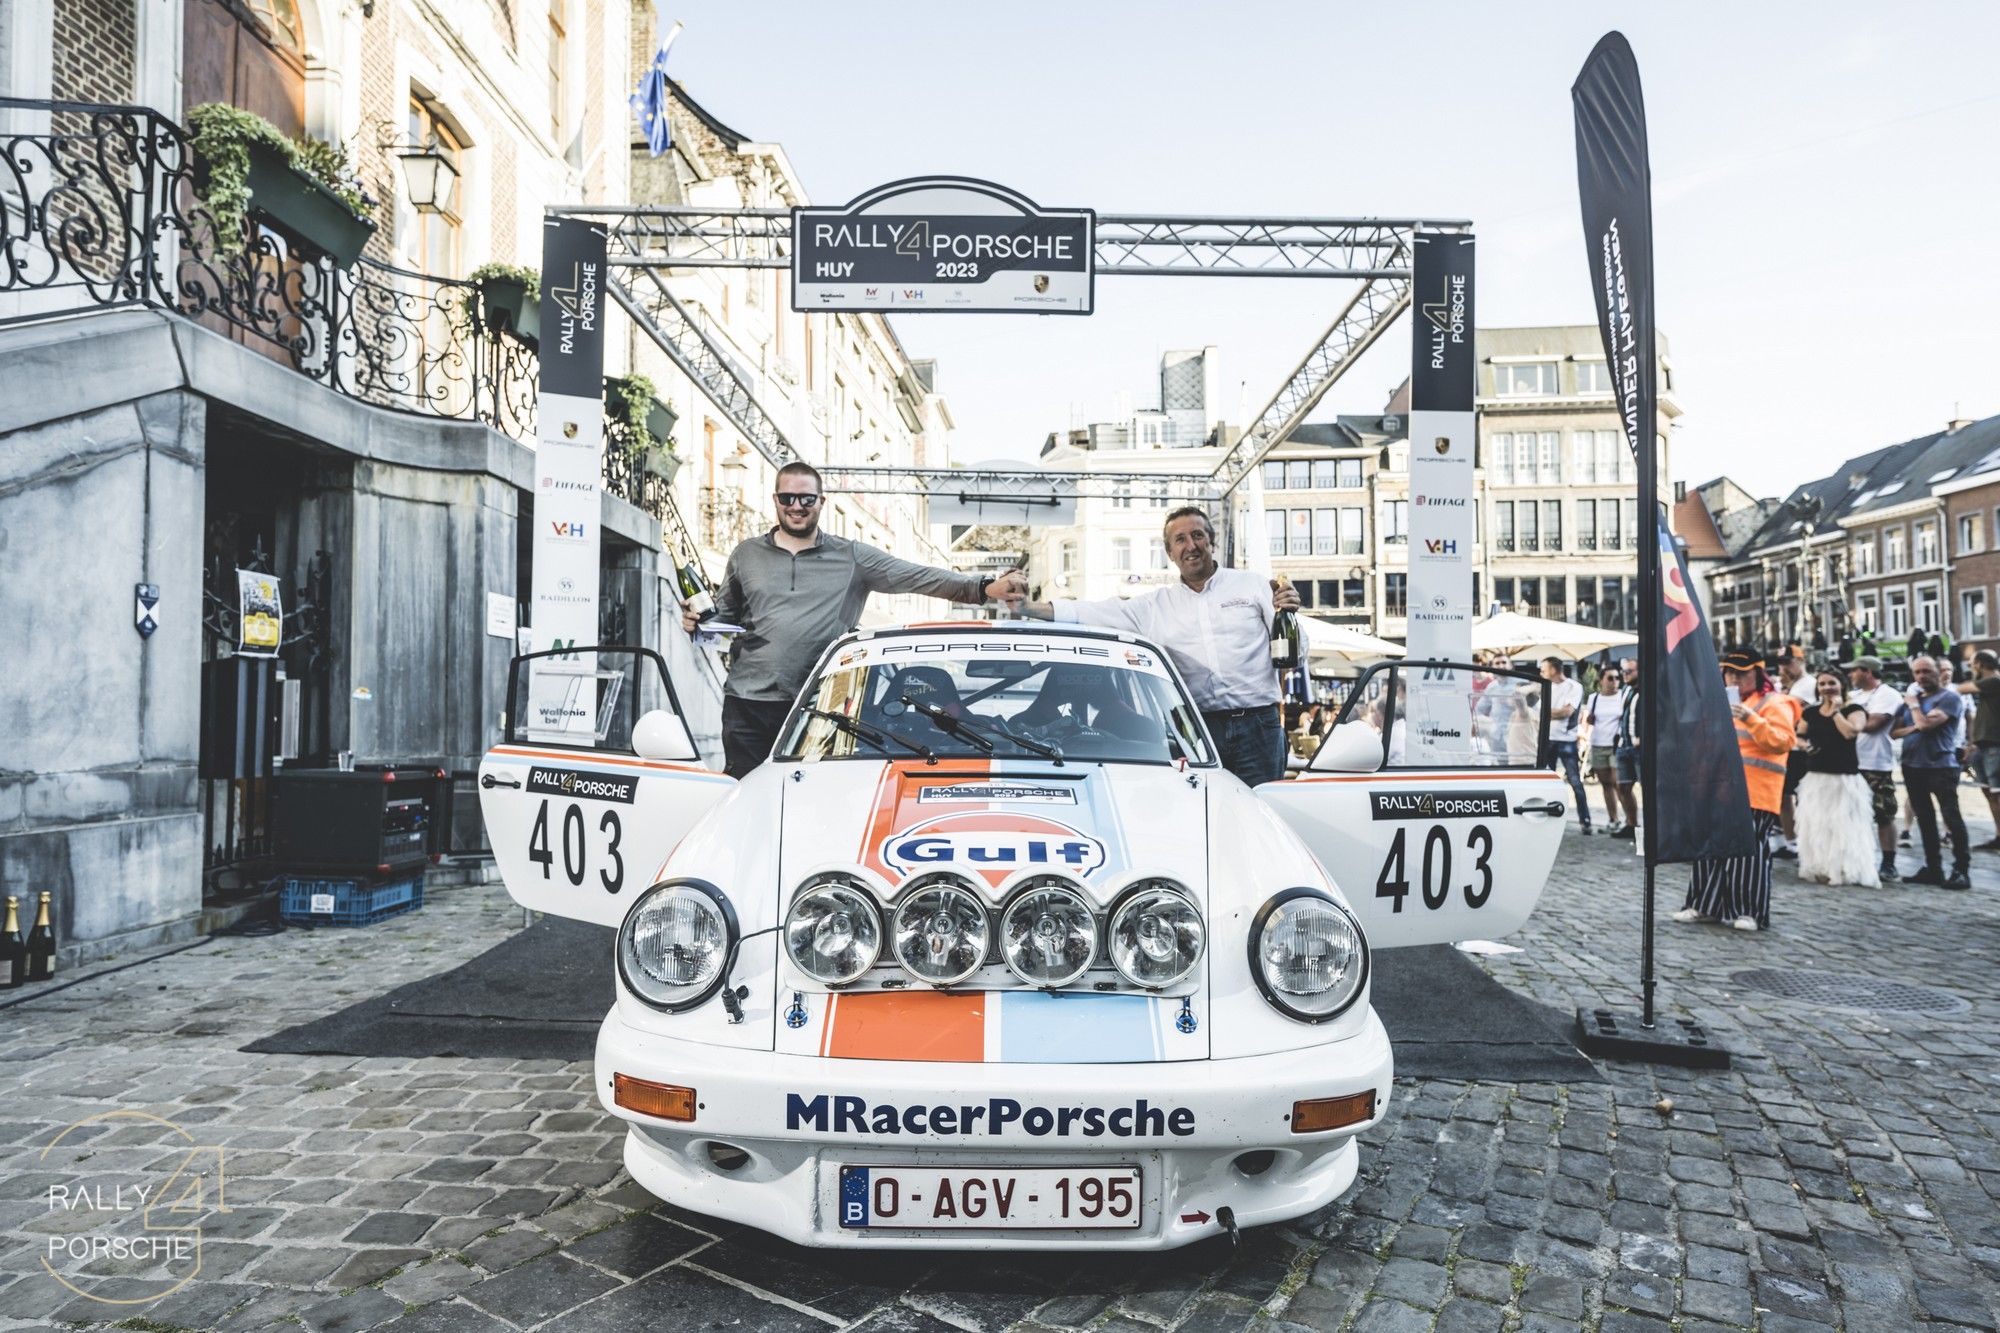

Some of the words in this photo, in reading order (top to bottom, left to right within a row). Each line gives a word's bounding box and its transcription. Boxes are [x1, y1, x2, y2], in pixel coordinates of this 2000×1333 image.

[815, 224, 905, 248] RALLY
[932, 234, 1074, 260] PORSCHE
[815, 262, 855, 278] HUY
[935, 262, 979, 278] 2023
[581, 262, 597, 332] PORSCHE
[1451, 275, 1466, 344] PORSCHE
[559, 309, 574, 355] RALLY
[1431, 326, 1445, 370] RALLY
[1428, 497, 1466, 507] EIFFAGE
[1415, 613, 1464, 621] RAIDILLON
[881, 643, 1110, 658] PORSCHE
[539, 708, 586, 716] Wallonia
[533, 771, 568, 785] RALLY
[574, 780, 630, 799] PORSCHE
[992, 789, 1065, 797] PORSCHE
[1379, 795, 1422, 810] RALLY
[1435, 799, 1500, 814] PORSCHE
[529, 799, 624, 895] 403
[896, 838, 1092, 865] Gulf
[1375, 824, 1493, 914] 403
[785, 1093, 1196, 1137] MRacerPorsche
[846, 1201, 864, 1222] B
